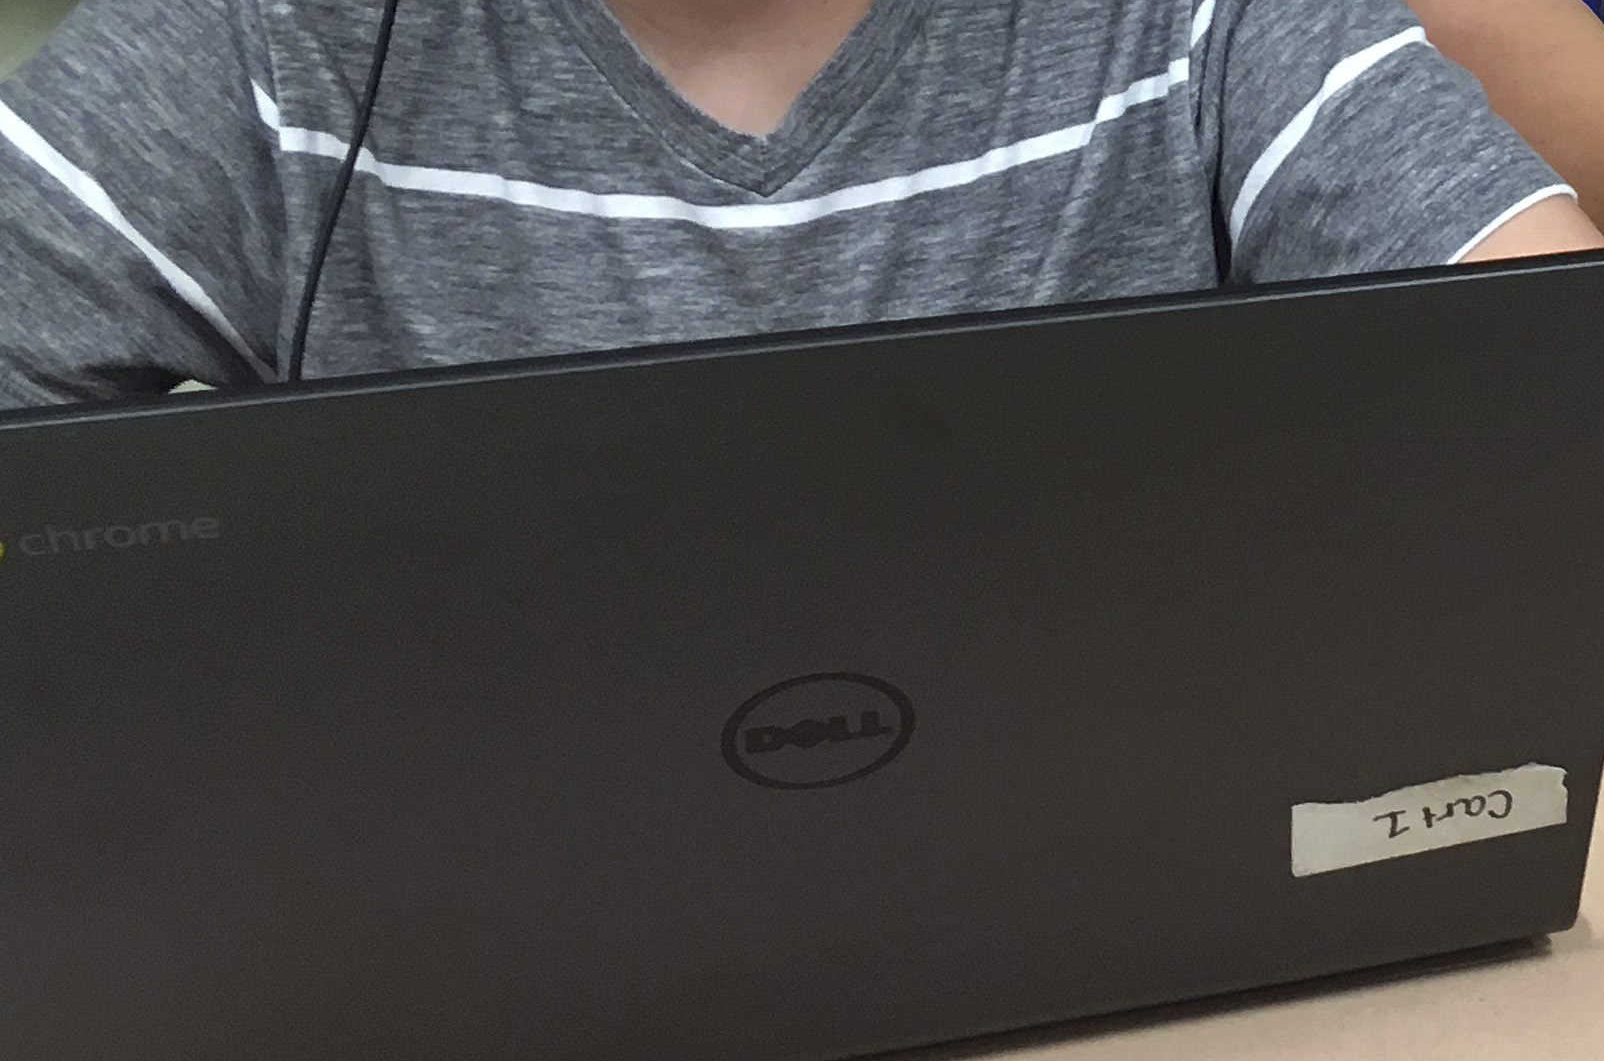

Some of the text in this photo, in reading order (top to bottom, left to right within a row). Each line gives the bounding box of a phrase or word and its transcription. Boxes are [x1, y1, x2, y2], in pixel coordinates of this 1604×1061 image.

[18, 516, 220, 556] chrome
[745, 710, 894, 753] DELL
[1422, 789, 1513, 829] Cart
